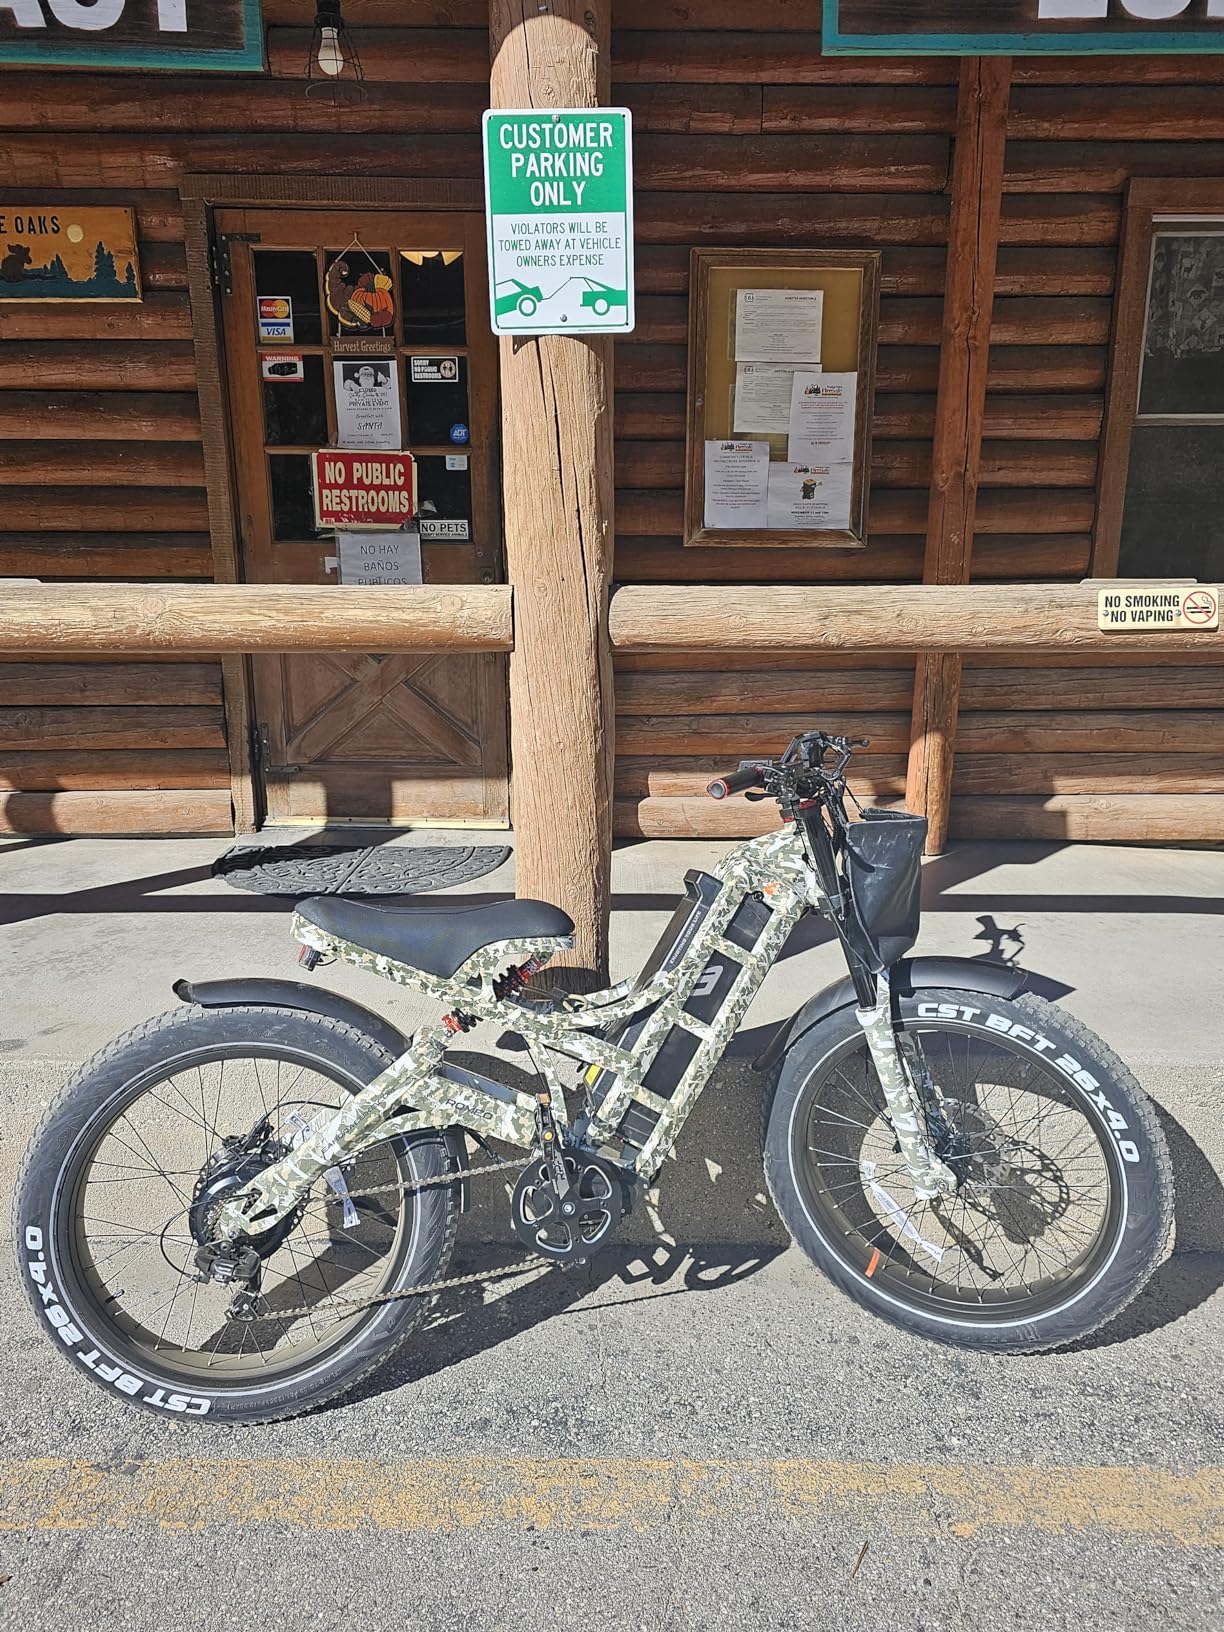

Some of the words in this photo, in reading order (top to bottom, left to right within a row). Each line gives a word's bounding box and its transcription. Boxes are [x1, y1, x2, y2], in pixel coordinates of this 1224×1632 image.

[499, 122, 613, 149] CUSTOMER
[511, 152, 604, 178] PARKING
[530, 181, 586, 206] ONLY
[14, 215, 61, 234] OAKS
[511, 222, 566, 235] VIOLATORS
[568, 221, 593, 234] WILL
[595, 221, 608, 233] BE
[499, 239, 531, 251] TOWED
[534, 238, 562, 251] AWAY
[564, 238, 577, 250] AT
[580, 237, 621, 249] VEHICLE
[516, 255, 557, 267] OWNERS
[559, 254, 604, 266] EXPENSE
[266, 327, 286, 336] VISA
[334, 340, 360, 352] Harvest
[360, 340, 391, 354] Greetings
[453, 428, 467, 438] ADT
[324, 461, 346, 484] NO
[352, 462, 405, 486] PUBLIC
[322, 489, 409, 513] RESTROOMS
[421, 523, 436, 532] NO
[440, 523, 467, 532] PETS
[360, 545, 376, 555] NO
[378, 545, 400, 555] HAY
[363, 559, 399, 572] BAÑOS
[1104, 595, 1121, 608] NO
[1125, 595, 1180, 608] SMOKING
[1110, 610, 1127, 623] NO
[1131, 609, 1174, 622] VAPING
[917, 1002, 982, 1021] CST
[984, 1013, 1057, 1051] BFT
[445, 1098, 493, 1121] ROMEO
[76, 1349, 145, 1396] BFT
[143, 1389, 211, 1416] CST
